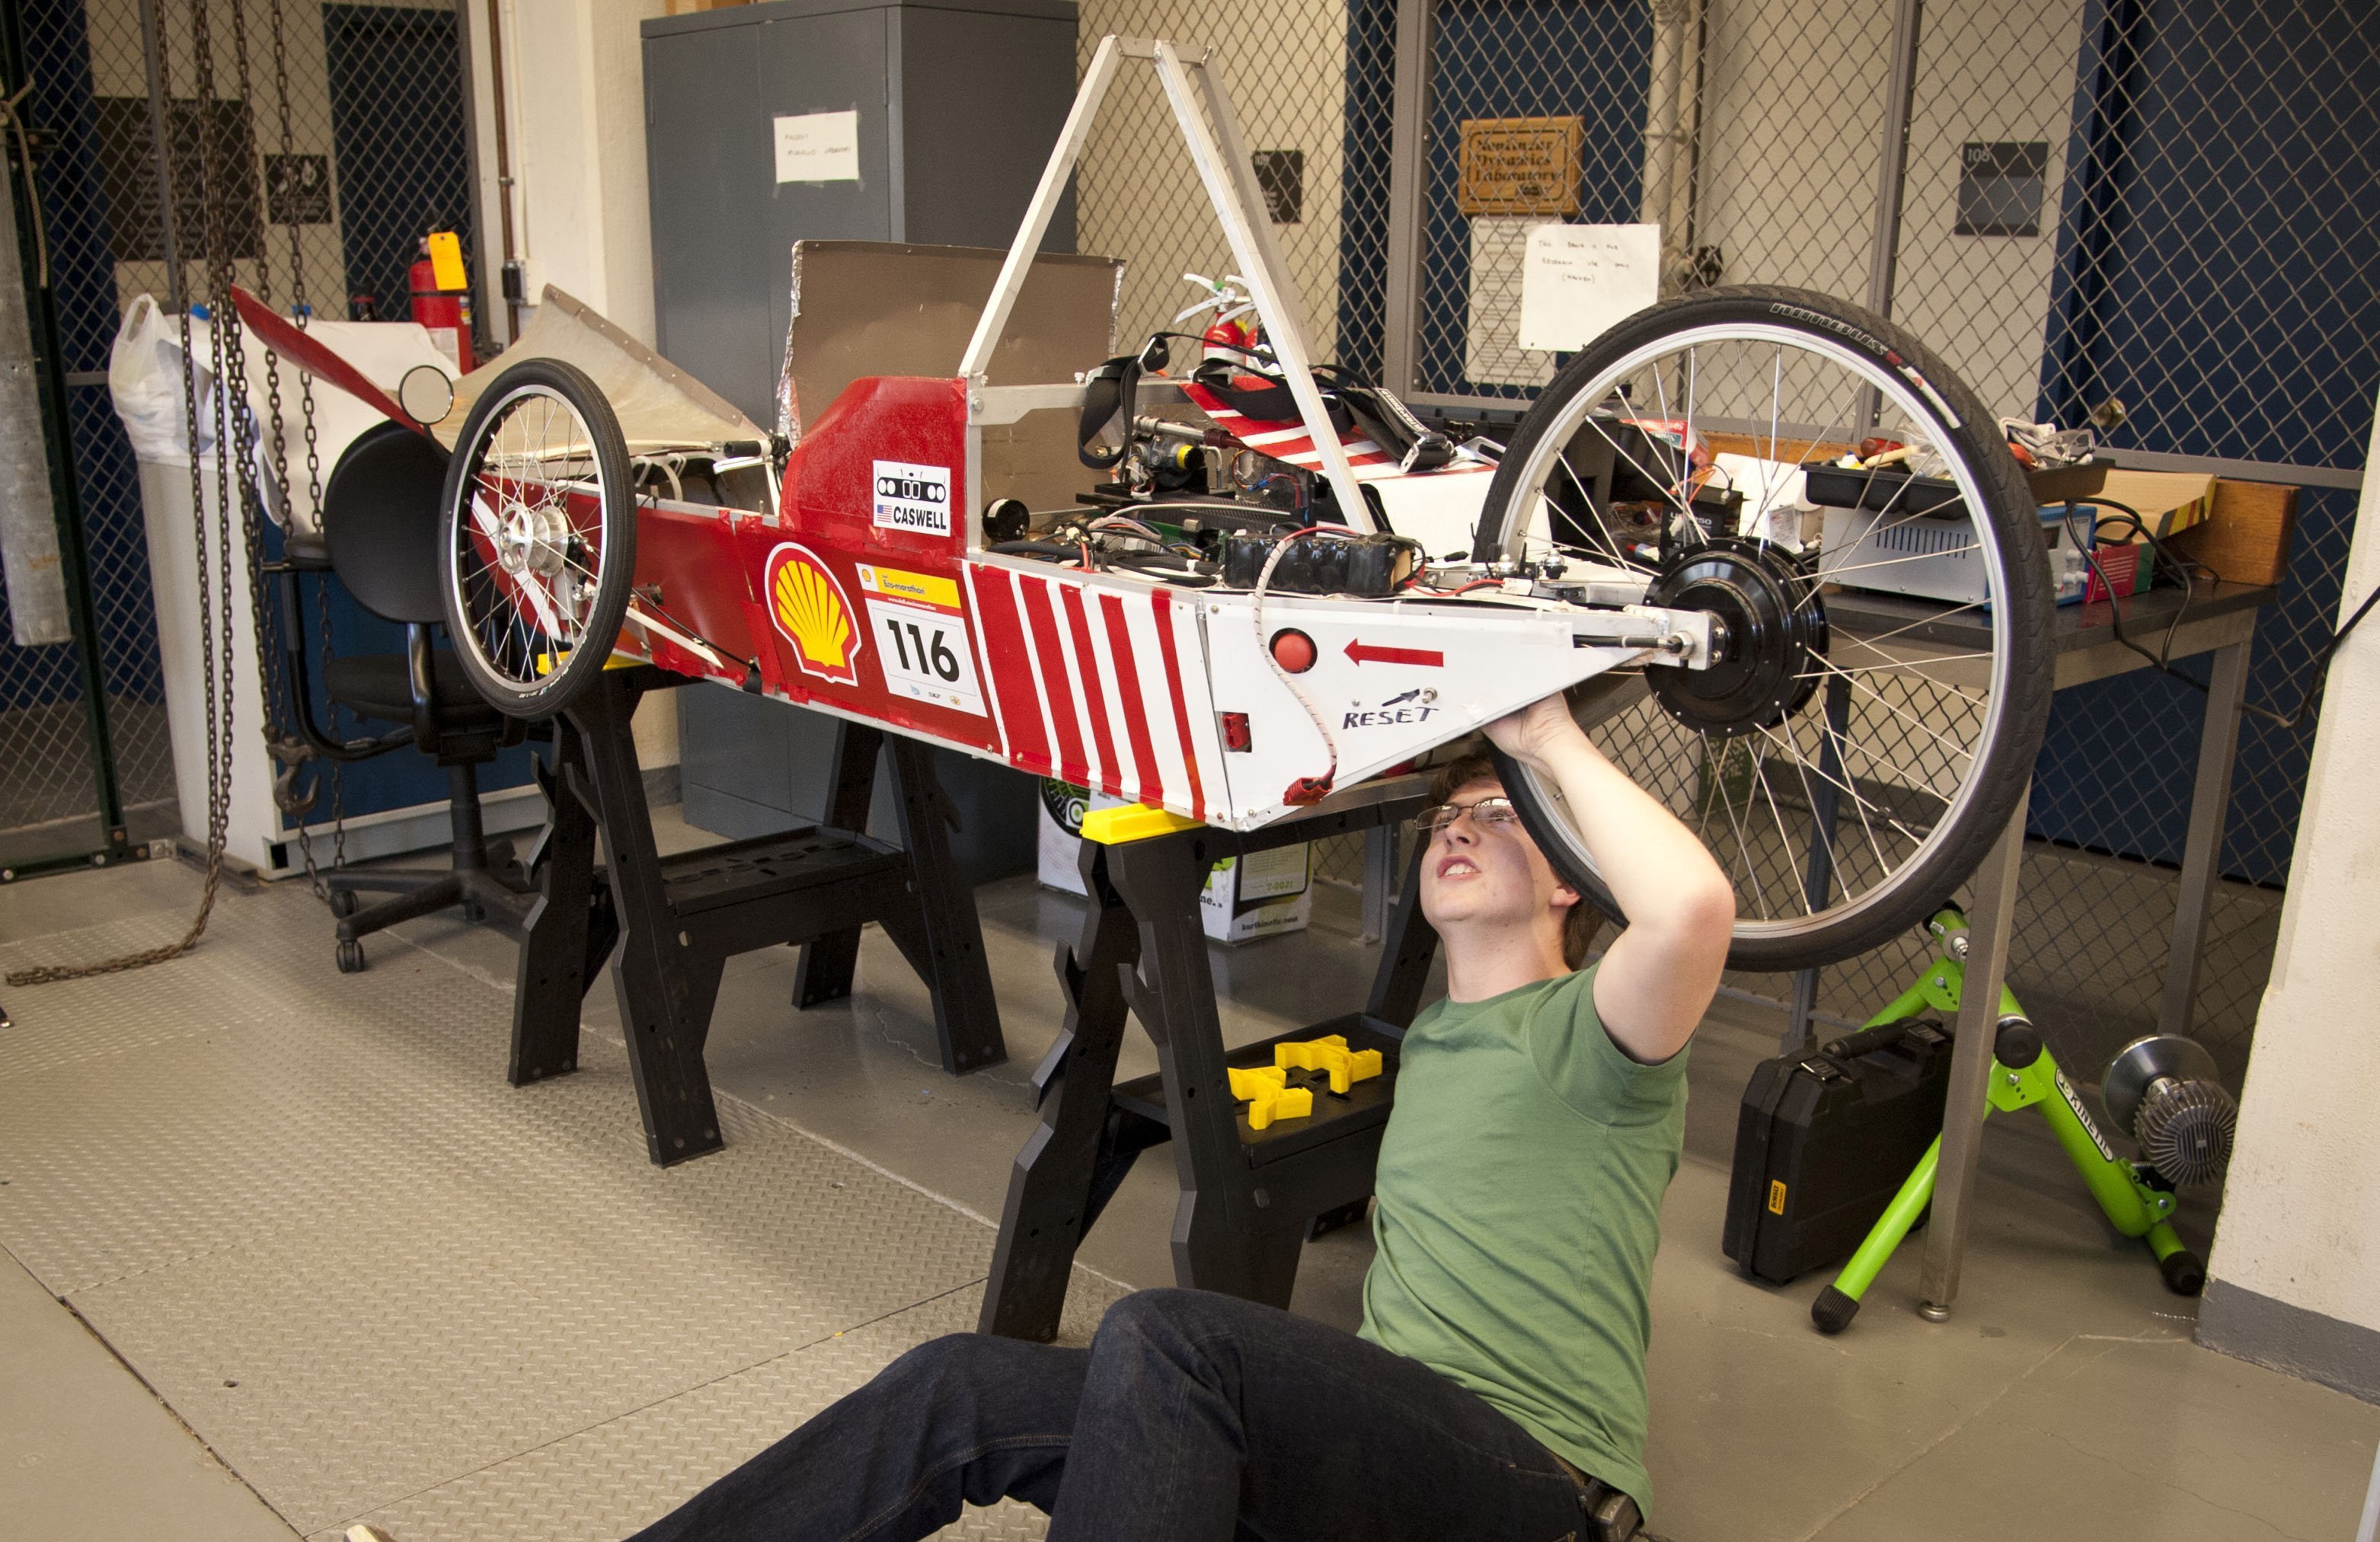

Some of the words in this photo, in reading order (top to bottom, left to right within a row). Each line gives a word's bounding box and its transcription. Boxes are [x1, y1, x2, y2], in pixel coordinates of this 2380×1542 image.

[893, 506, 947, 530] CASWELL
[887, 618, 960, 682] 116
[1342, 707, 1439, 729] RESET
